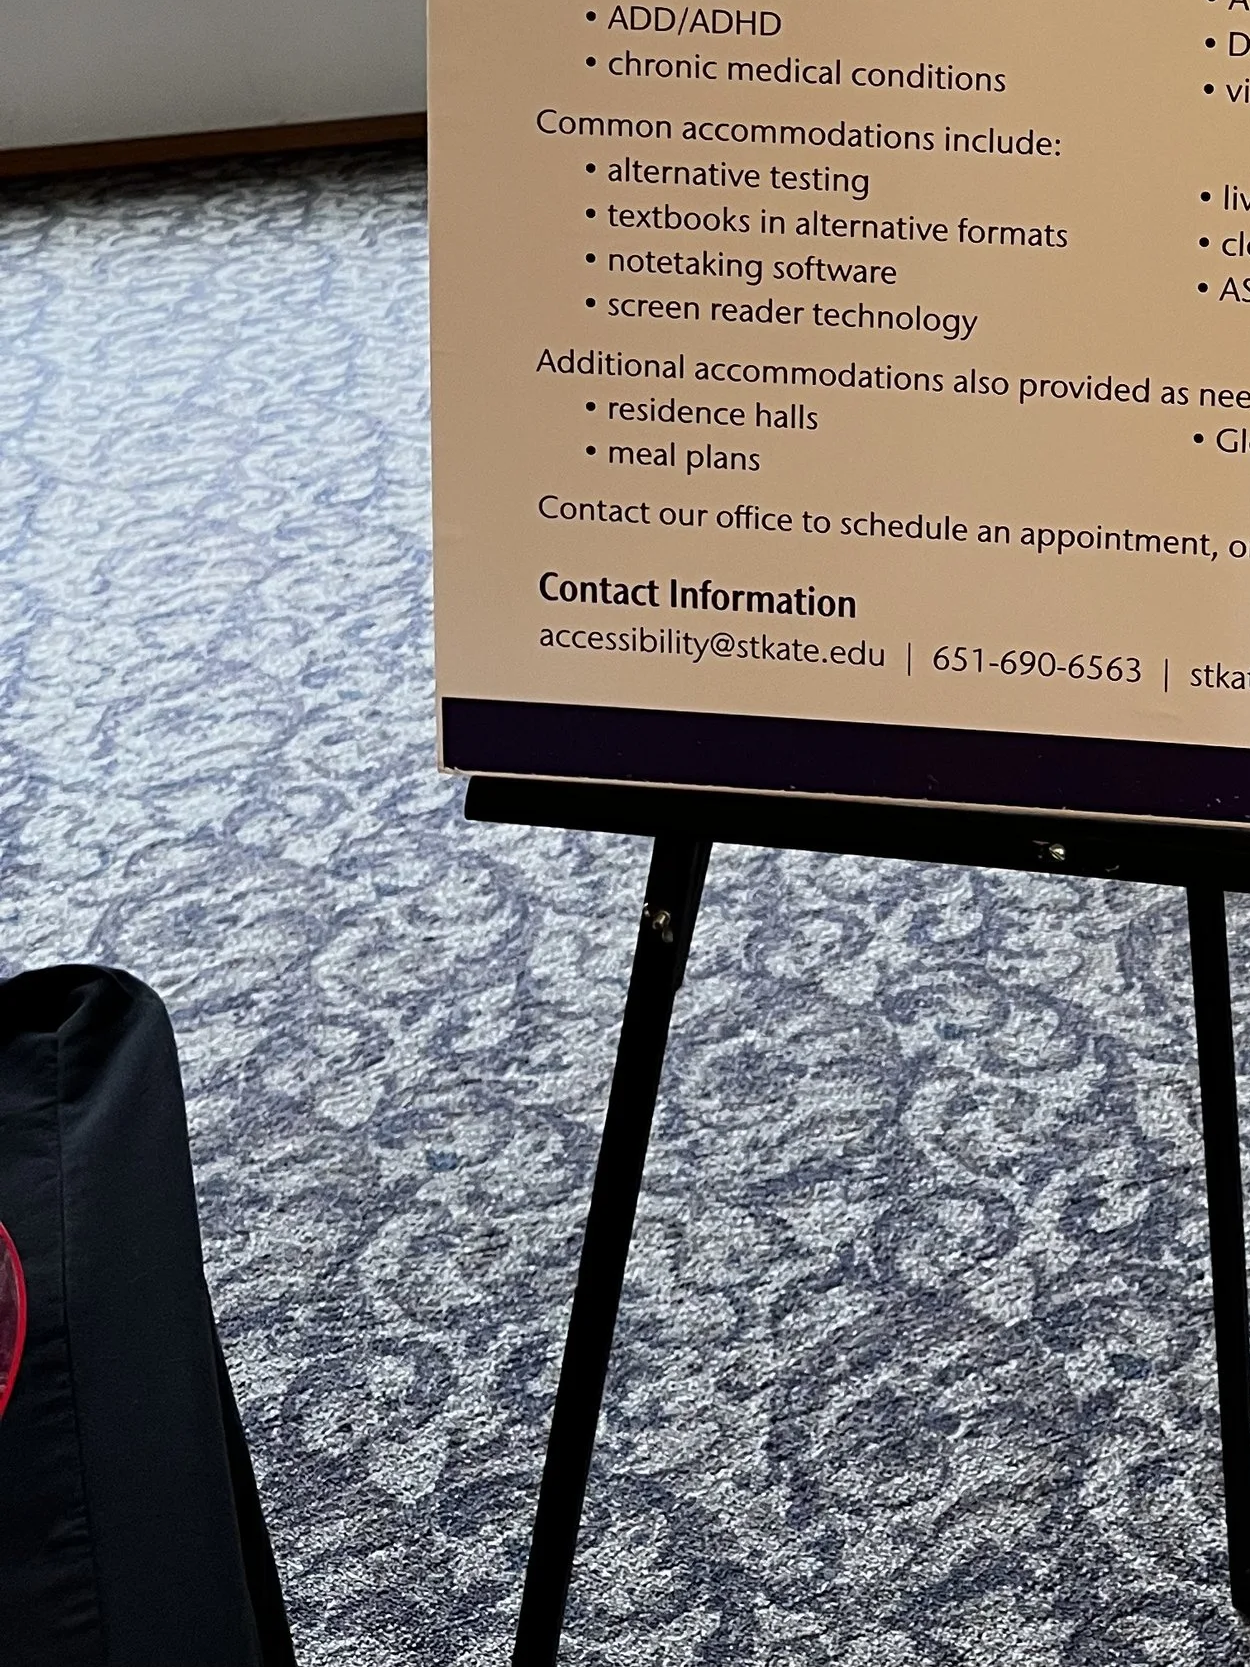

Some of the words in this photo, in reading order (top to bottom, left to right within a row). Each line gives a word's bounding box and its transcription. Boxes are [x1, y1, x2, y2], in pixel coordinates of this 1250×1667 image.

[607, 4, 782, 37] ADD/ADHD
[608, 49, 718, 80] chronic
[727, 56, 841, 86] medical
[851, 62, 1006, 93] conditions
[536, 108, 672, 140] Common
[681, 120, 935, 151] accommodations
[945, 125, 1061, 157] include:
[607, 156, 761, 189] alternative
[769, 165, 869, 201] testing
[607, 203, 751, 234] textbooks
[760, 208, 786, 235] in
[795, 209, 949, 243] alternative
[957, 217, 1068, 248] formats
[608, 249, 763, 287] notetaking
[772, 254, 897, 285] software
[607, 297, 700, 321] screen
[711, 297, 806, 325] reader
[811, 302, 979, 341] technology
[535, 348, 685, 380] Additional
[694, 361, 944, 393] accommodations
[953, 367, 1010, 396] also
[1019, 374, 1150, 405] provided
[1160, 385, 1190, 406] as
[608, 397, 746, 427] residence
[755, 401, 818, 431] halls
[608, 441, 676, 467] meal
[686, 443, 761, 476] plans
[538, 494, 652, 525] Contact
[658, 507, 709, 527] our
[716, 504, 793, 532] office
[801, 510, 831, 534] to
[839, 510, 968, 542] schedule
[977, 524, 1010, 545] an
[1020, 524, 1218, 562] appointment,
[539, 571, 661, 608] Contact
[670, 578, 856, 619] Information
[539, 626, 885, 667] accessibility@stkate.edu
[932, 645, 1142, 684] 651-690-6563
